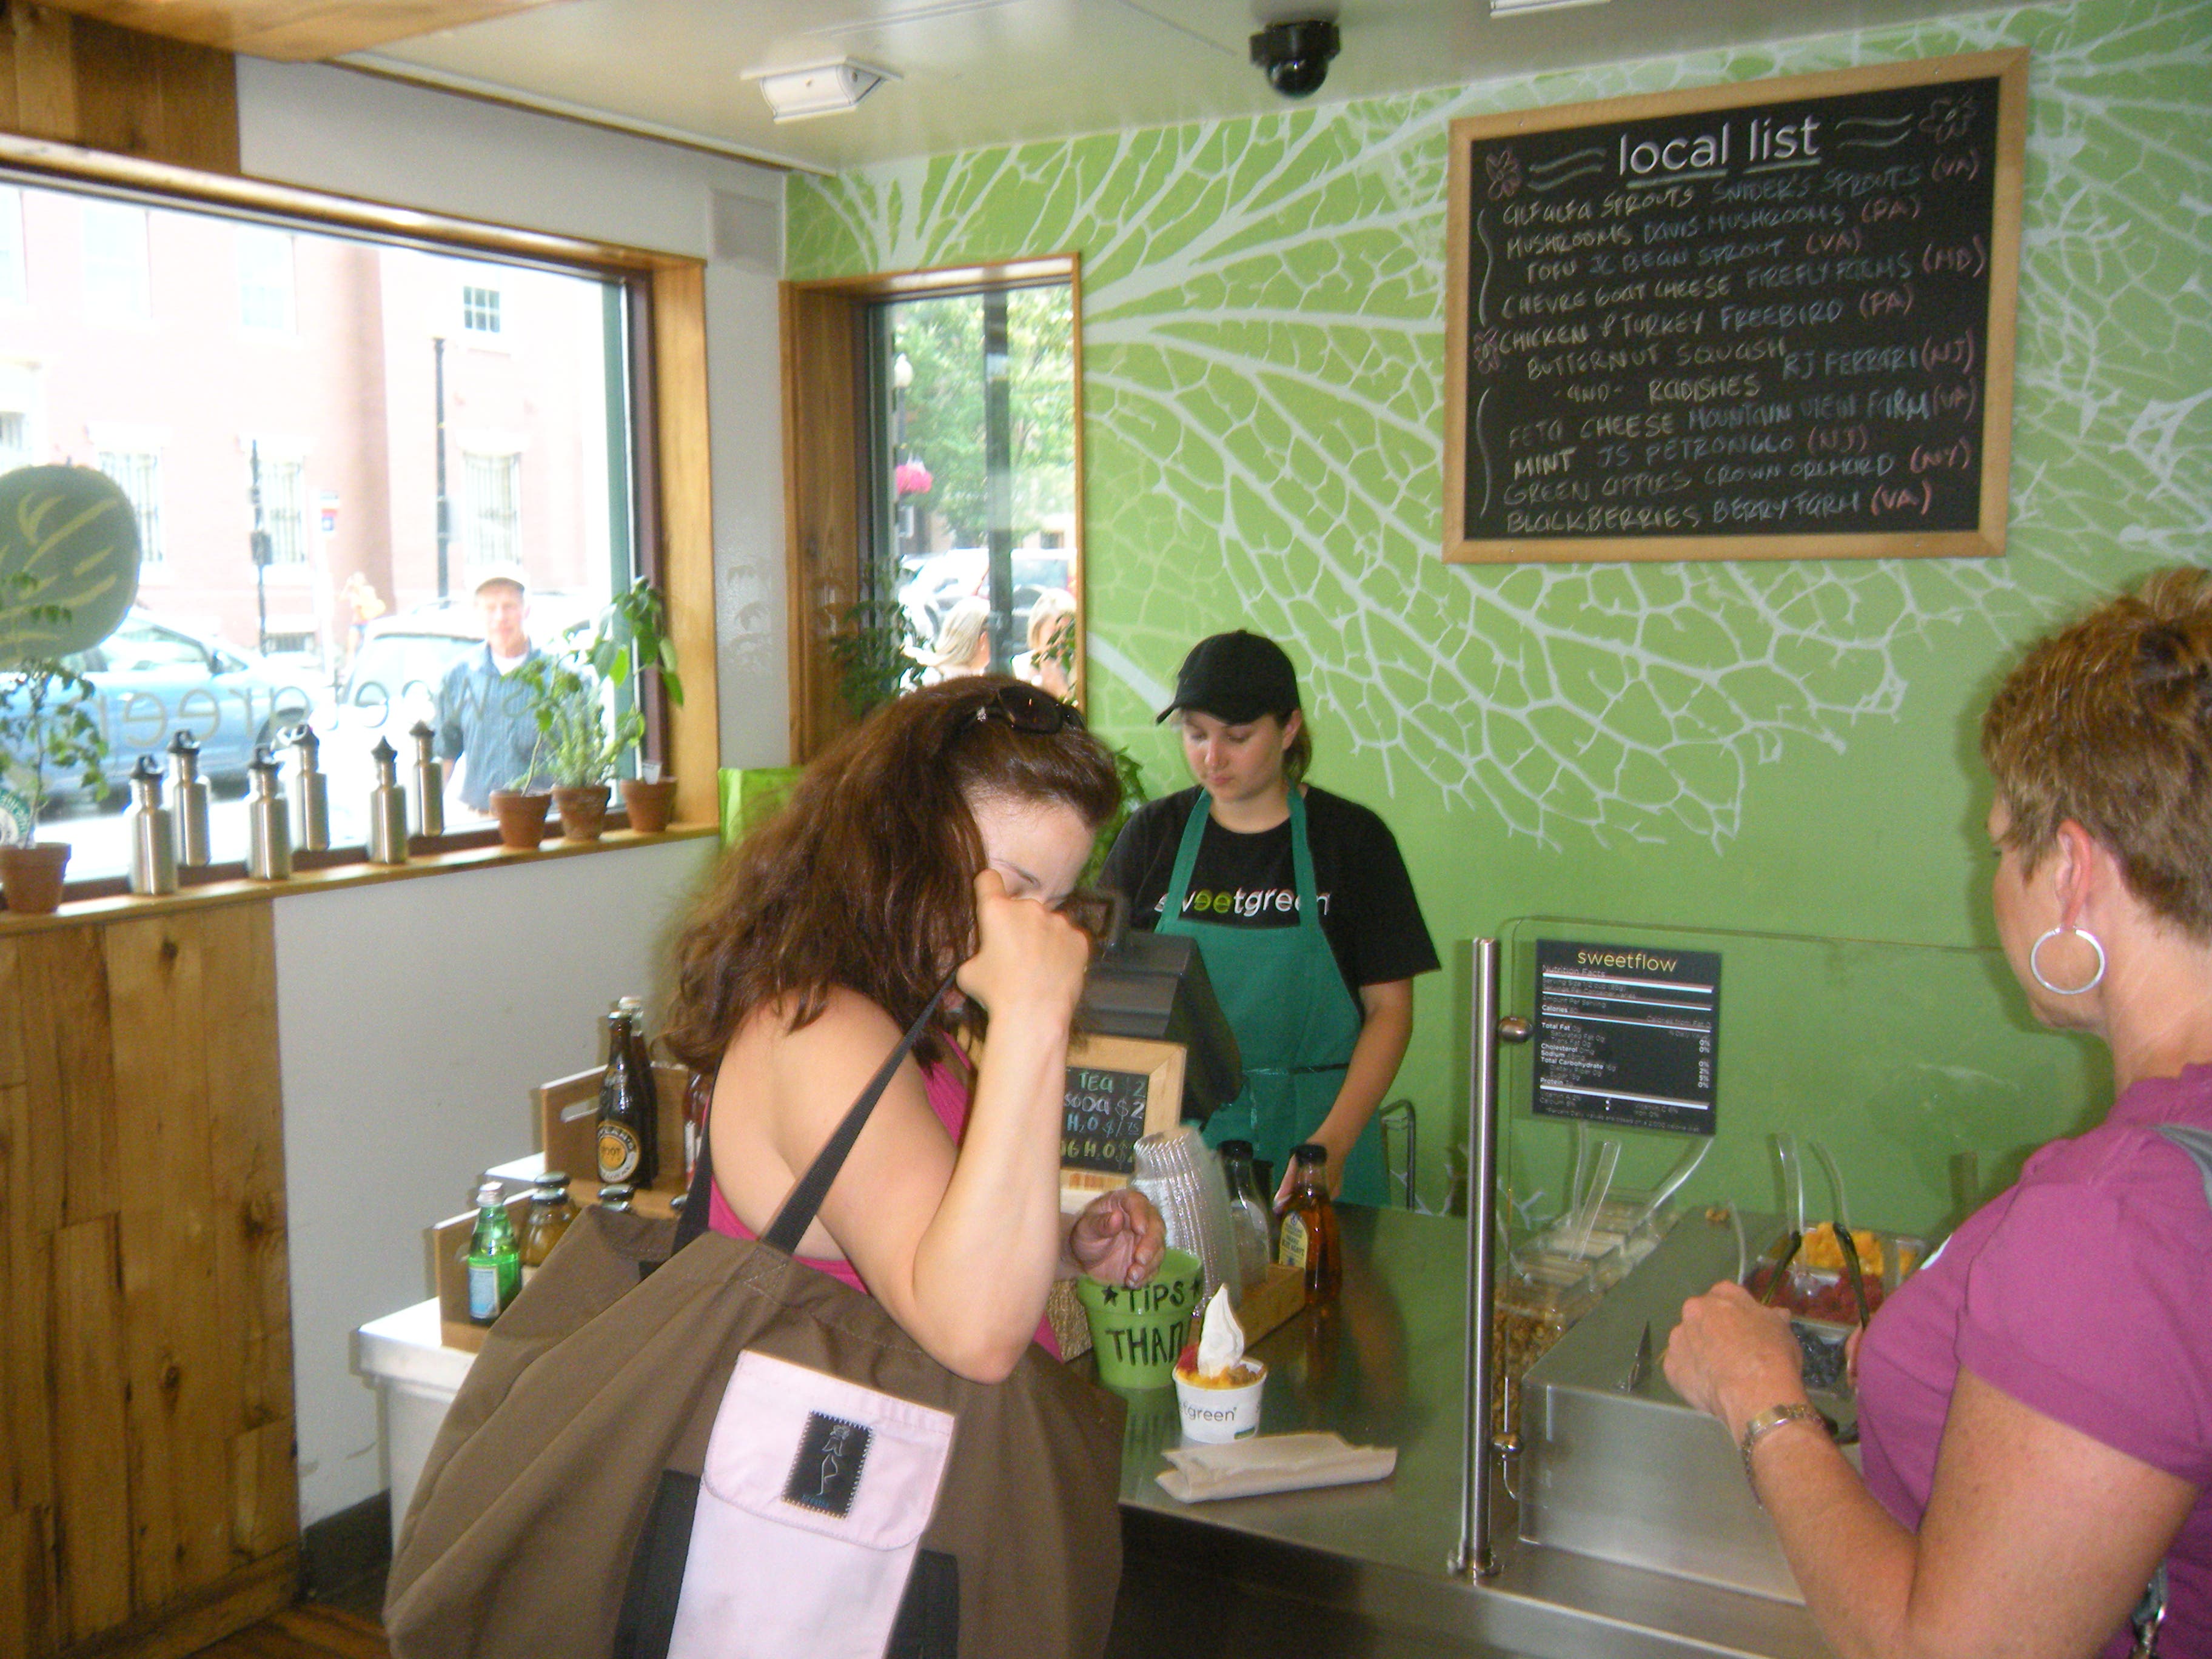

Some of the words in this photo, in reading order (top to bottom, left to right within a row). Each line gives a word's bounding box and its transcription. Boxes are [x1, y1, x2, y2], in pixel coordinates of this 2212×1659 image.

[1620, 122, 1729, 176] local
[1749, 115, 1820, 161] list
[1601, 185, 1695, 218] SPROUTS
[1507, 223, 1633, 260] MUSHROOMS
[1708, 203, 1845, 232] MUSHROOMS
[1861, 194, 1921, 224] (PA)
[1527, 258, 1577, 284] TOFU
[1698, 236, 1785, 266] SPROUT
[1806, 224, 1863, 255] (VA)
[1501, 290, 1587, 319] CHEVRE
[1654, 274, 1731, 299] CHEESE
[1499, 323, 1590, 354] CHICKEN
[1622, 309, 1706, 338] TURKEY
[1721, 299, 1843, 332] FREEBIRD
[1859, 282, 1914, 320] (PA)
[1528, 341, 1660, 381] BUTTERNUT
[1677, 337, 1787, 366] SQUASH
[1649, 372, 1760, 404] RADISHES
[1580, 412, 1674, 438] CHEESE
[1514, 446, 1577, 480] MINT
[1504, 480, 1590, 505] GREEN
[1871, 478, 1932, 516] (VA)
[1154, 888, 1330, 917] sweetgren
[1577, 951, 1677, 972] sweetflow
[1542, 1004, 1568, 1013] Calories
[1541, 1043, 1578, 1053] Cholesterol
[1558, 1059, 1604, 1070] Carbohydrate
[1080, 1071, 1114, 1093] TEA
[1115, 1098, 1146, 1121] $2
[1121, 1281, 1184, 1312] TIPS
